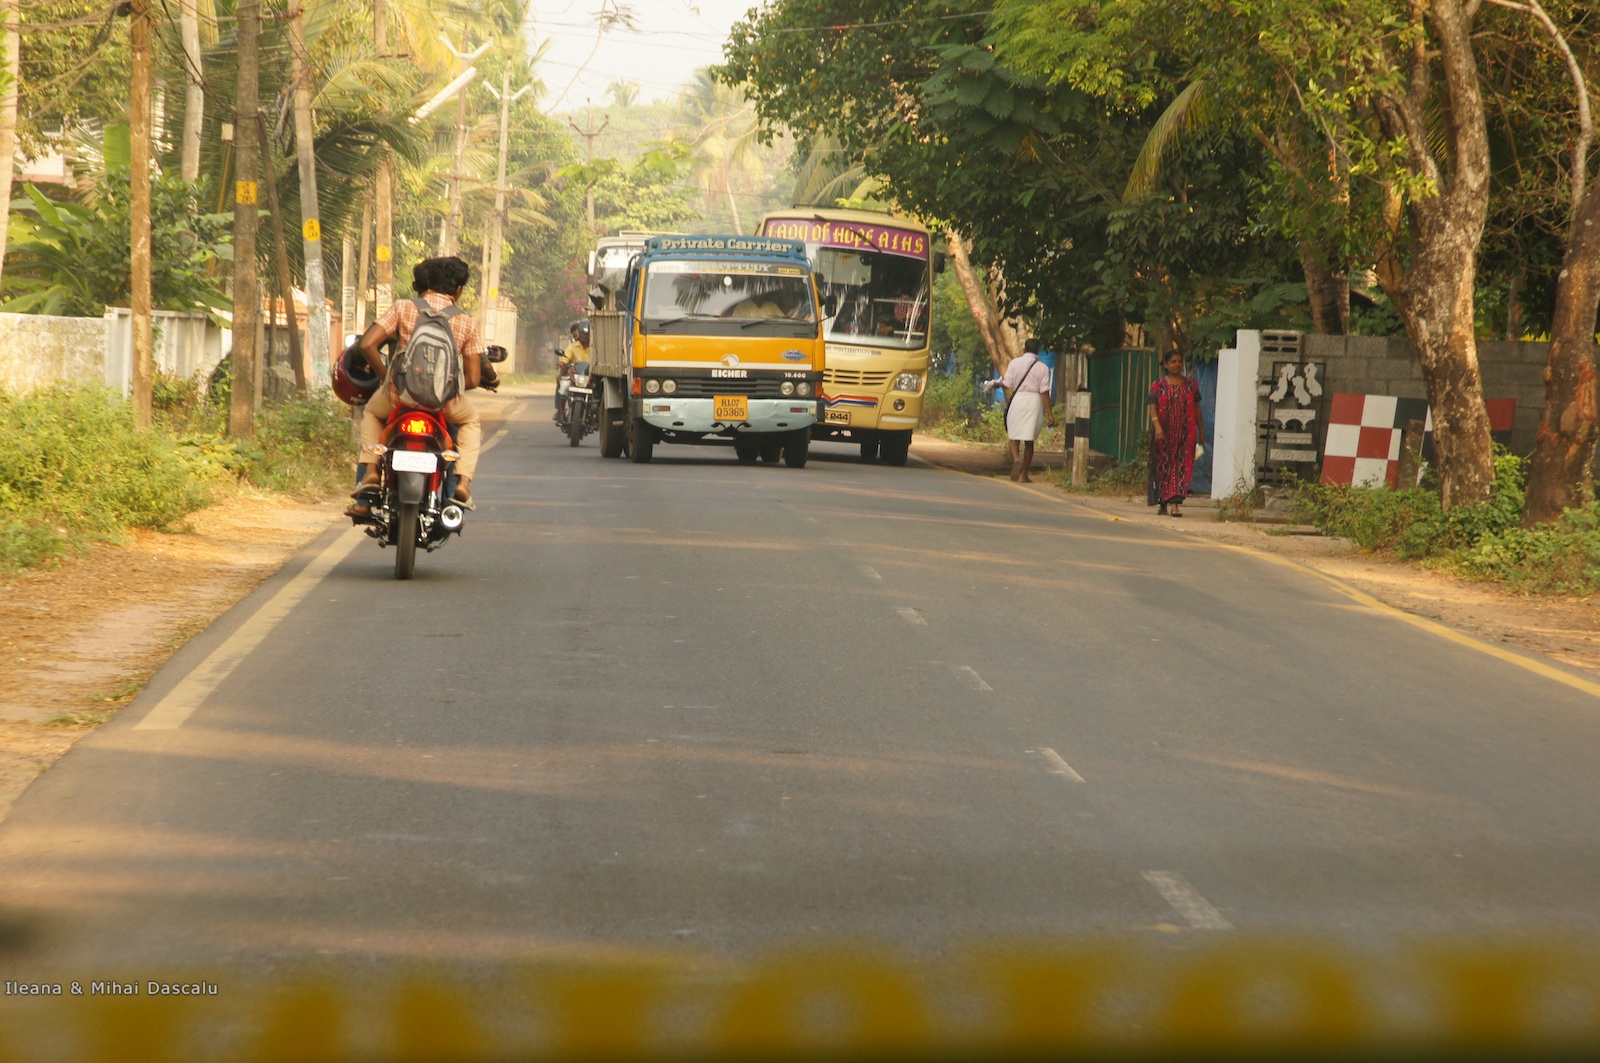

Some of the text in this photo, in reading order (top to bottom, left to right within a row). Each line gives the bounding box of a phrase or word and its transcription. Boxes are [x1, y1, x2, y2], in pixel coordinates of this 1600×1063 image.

[661, 237, 792, 253] Private Carrier
[711, 369, 748, 378] EICHER
